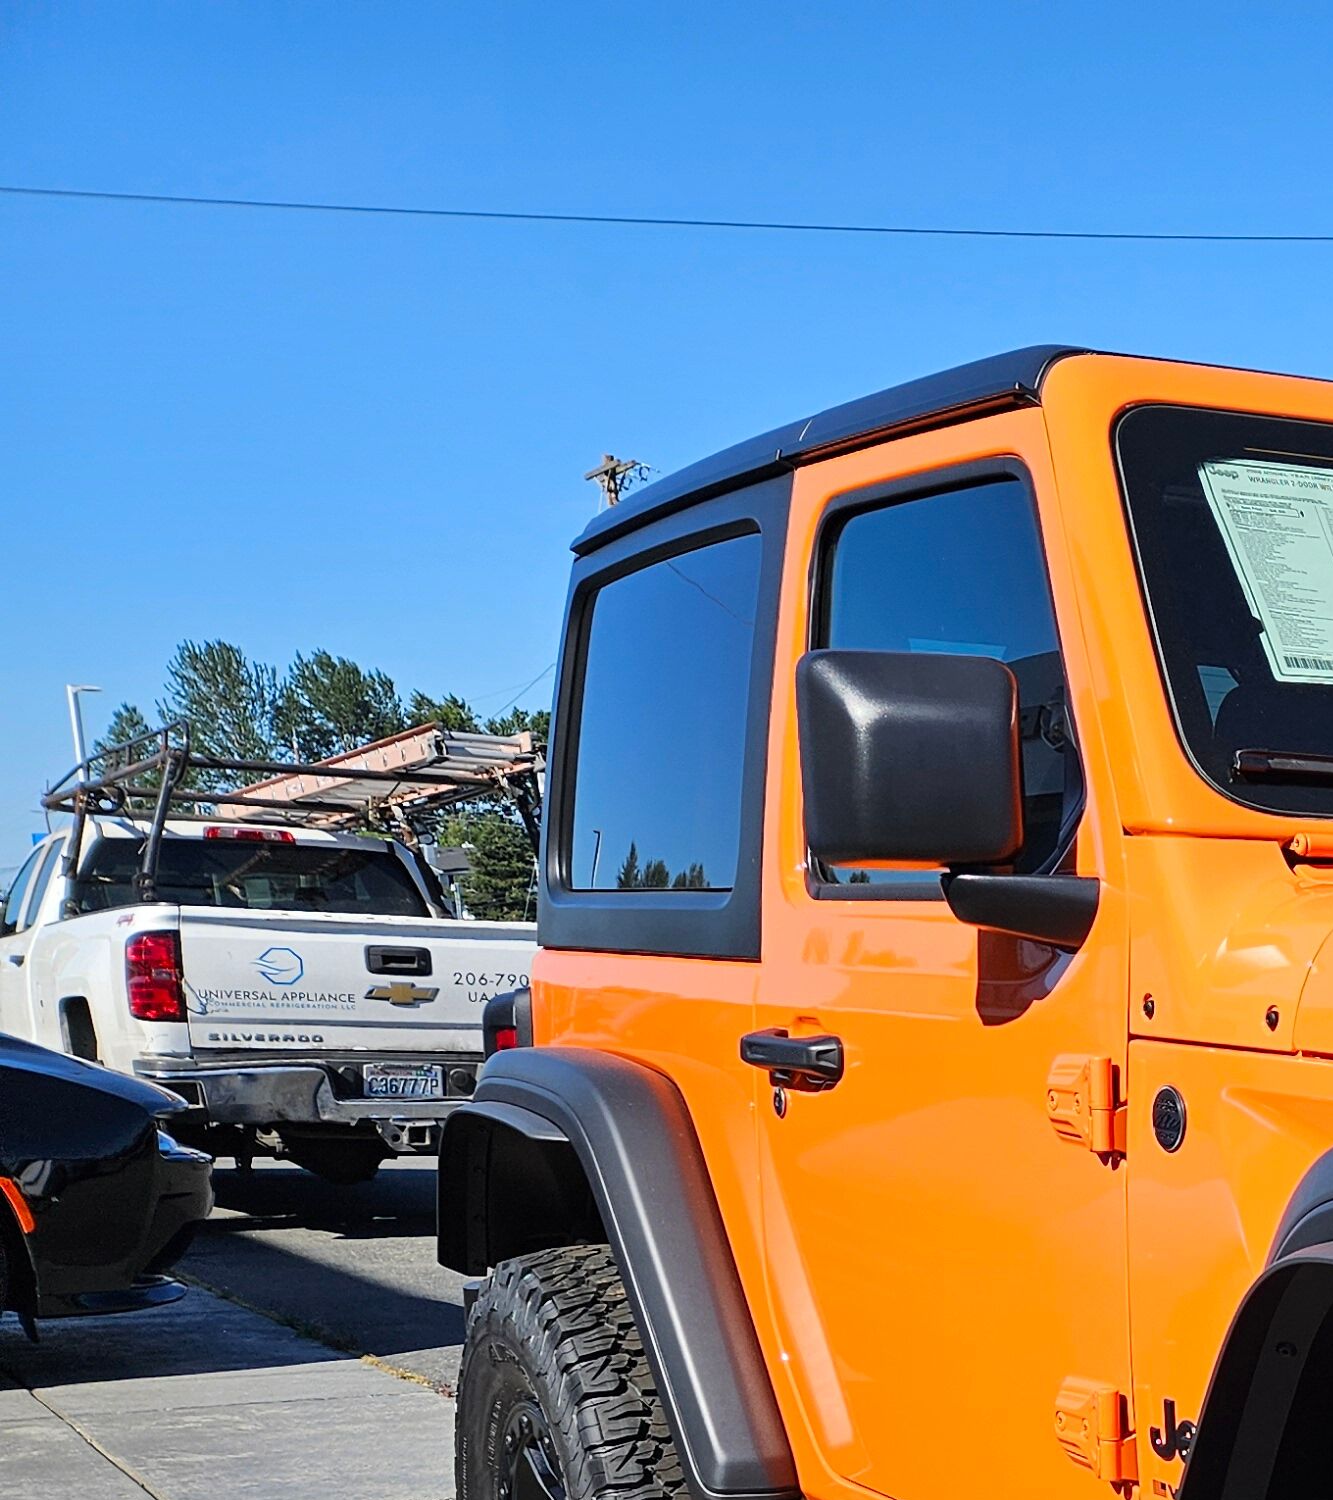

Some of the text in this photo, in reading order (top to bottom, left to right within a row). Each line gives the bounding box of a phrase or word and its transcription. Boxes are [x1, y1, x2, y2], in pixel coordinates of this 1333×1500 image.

[1208, 466, 1239, 480] Jeep
[1247, 476, 1289, 487] WRANGLER
[198, 988, 356, 1003] UNIVERSAL APPLIANCE
[208, 1000, 266, 1008] COMMERCIAL
[270, 1002, 338, 1010] REFRIGERATION
[208, 1032, 324, 1043] SILVERADO
[369, 1077, 438, 1094] C36777P
